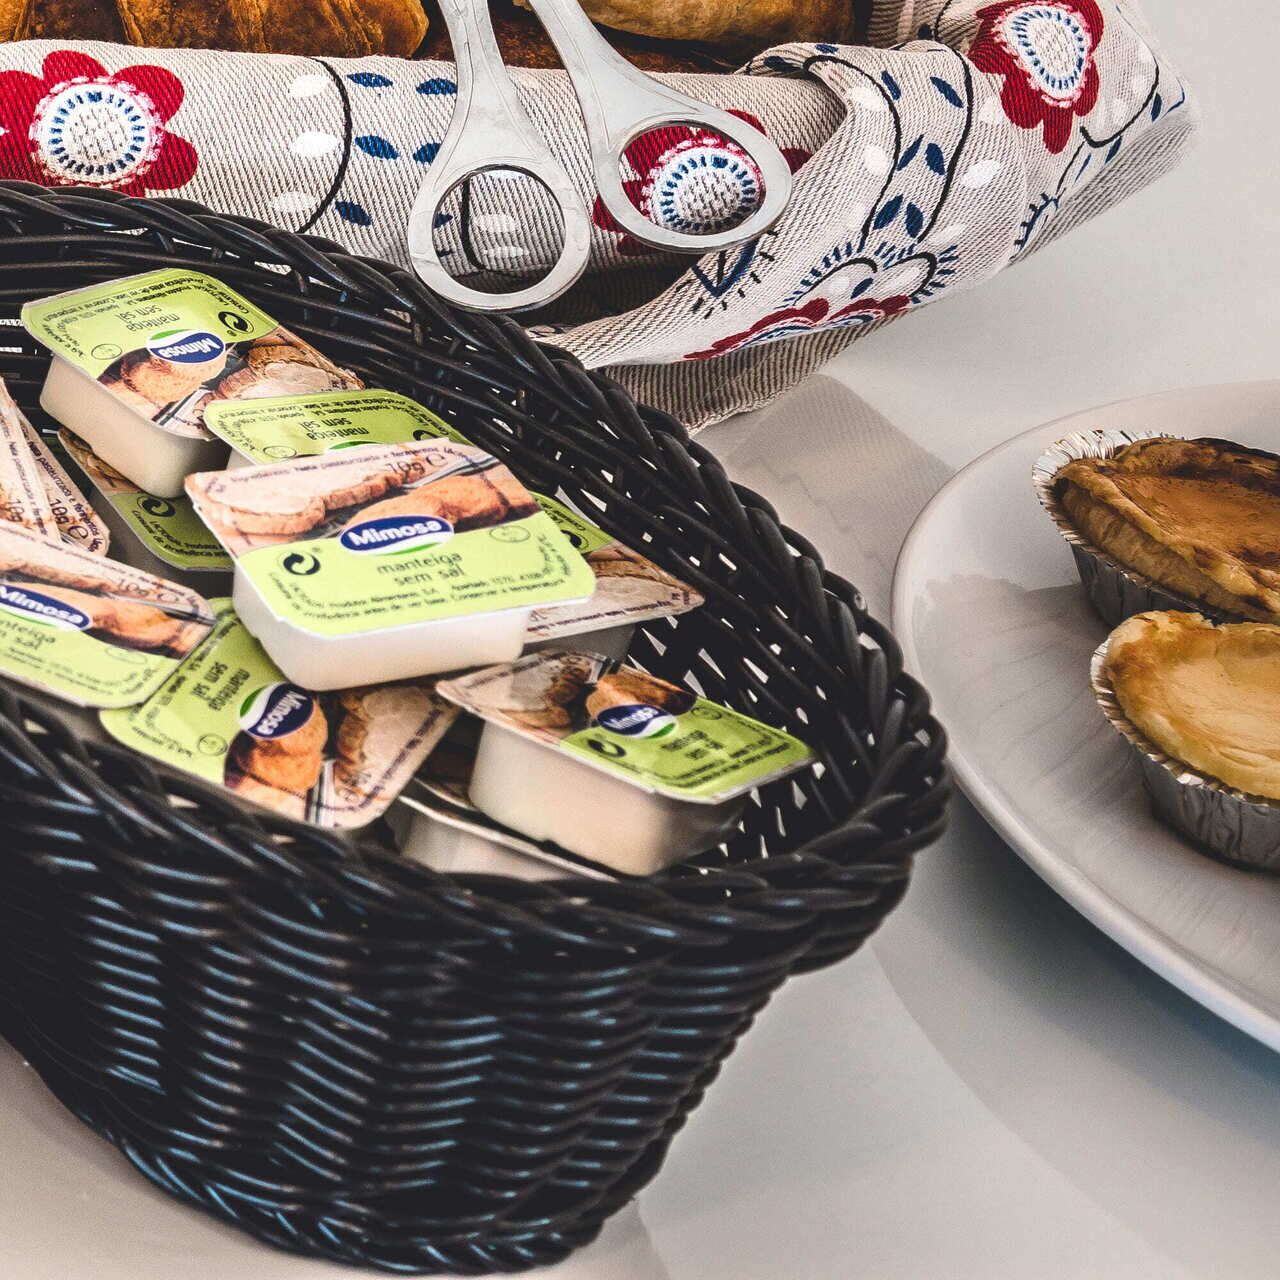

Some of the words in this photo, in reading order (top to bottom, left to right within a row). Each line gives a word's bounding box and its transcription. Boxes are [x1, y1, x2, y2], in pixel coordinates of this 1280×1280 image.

[125, 312, 180, 332] manteiga
[156, 341, 220, 359] Mimosa
[306, 425, 368, 440] manteiga
[386, 456, 425, 480] 10g
[37, 456, 73, 498] pasteurizada
[72, 503, 100, 537] fermentos
[3, 499, 27, 524] 10g
[47, 498, 71, 526] 10g
[350, 518, 441, 545] Mimosa
[376, 550, 462, 576] manteiga
[394, 572, 432, 587] sem
[440, 564, 464, 579] sal
[16, 634, 42, 653] sal
[204, 662, 228, 684] sem
[191, 683, 213, 699] sal
[206, 668, 251, 711] manteiga
[257, 691, 304, 735] Mimosa
